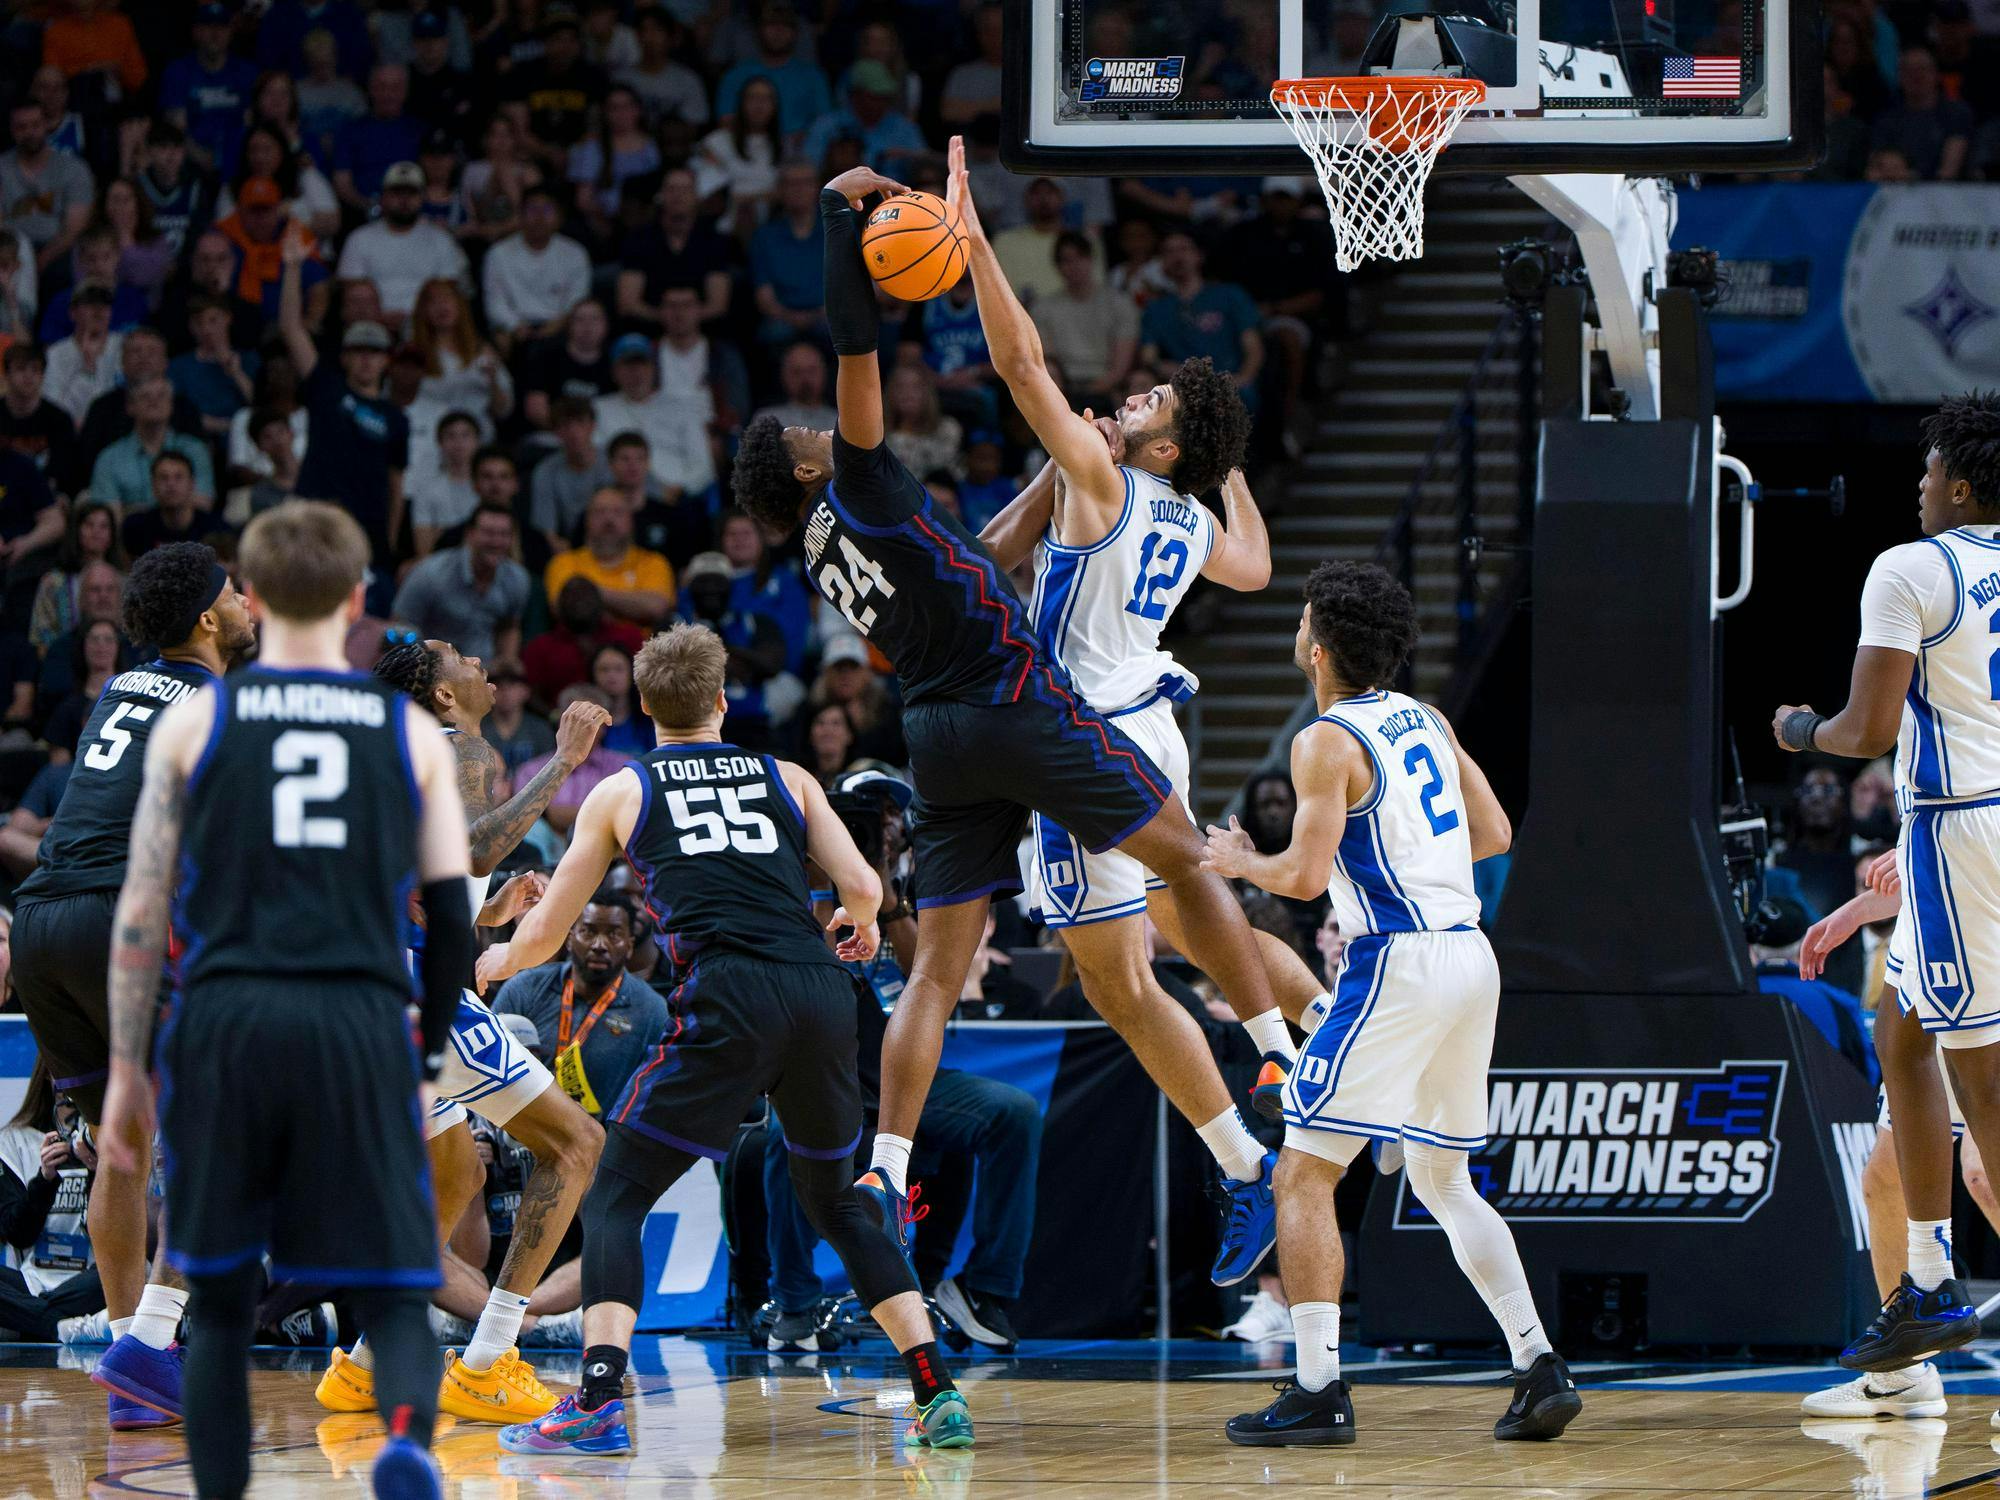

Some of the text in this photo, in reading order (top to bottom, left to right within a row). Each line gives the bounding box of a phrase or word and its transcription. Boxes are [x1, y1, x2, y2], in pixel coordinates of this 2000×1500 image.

[1103, 62, 1155, 77] MARCH
[1109, 78, 1180, 93] MADNESS
[1150, 500, 1199, 536] BOOZER
[819, 534, 896, 636] 24
[1124, 532, 1189, 621] 12
[110, 671, 198, 705] ROBINSON
[236, 684, 386, 728] HARDING
[84, 702, 154, 771] 5
[1378, 709, 1427, 747] BOZER
[652, 757, 765, 782] TOOLSON
[272, 730, 349, 849] 2
[1404, 743, 1459, 837] 2
[664, 783, 779, 856] 55
[1047, 861, 1075, 888] D
[1928, 961, 1960, 988] D
[461, 1022, 496, 1055] D
[1299, 1055, 1329, 1085] D
[1487, 1082, 1680, 1136] MARCH
[1507, 1140, 1770, 1195] MADNESS
